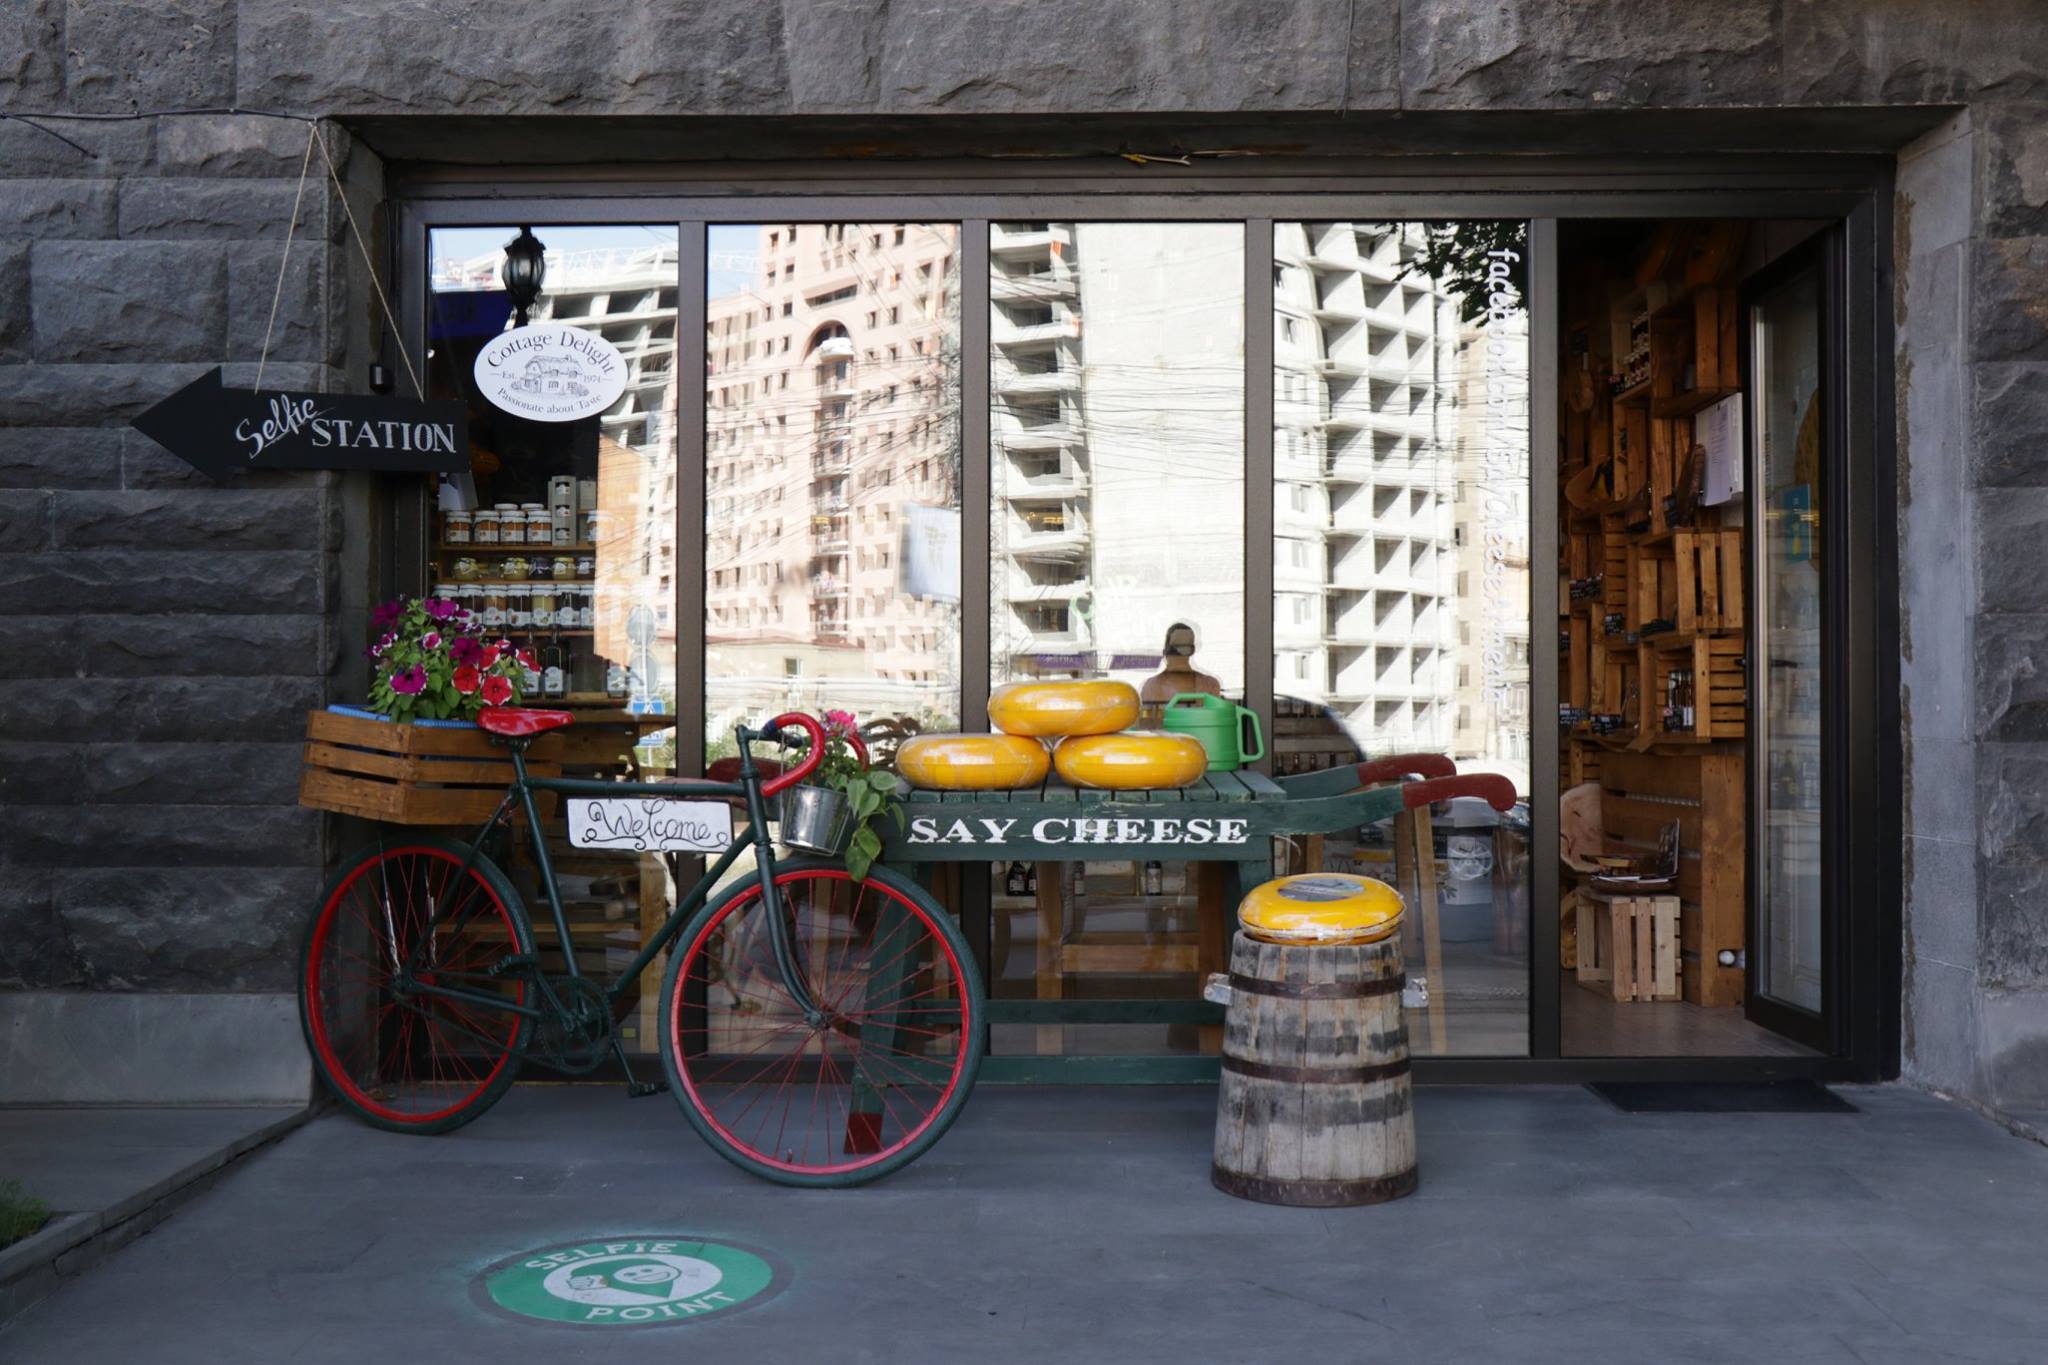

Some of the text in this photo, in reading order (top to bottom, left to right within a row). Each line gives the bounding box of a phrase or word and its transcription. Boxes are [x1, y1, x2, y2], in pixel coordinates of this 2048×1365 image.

[488, 332, 615, 374] Cottage Delight
[497, 387, 602, 414] Passionate about Taste
[235, 394, 457, 460] Selfie STATION
[588, 798, 712, 842] Welcome
[907, 817, 1250, 844] SAY CHEESE
[525, 1242, 678, 1271] SELFIE
[586, 1291, 738, 1321] POINT
